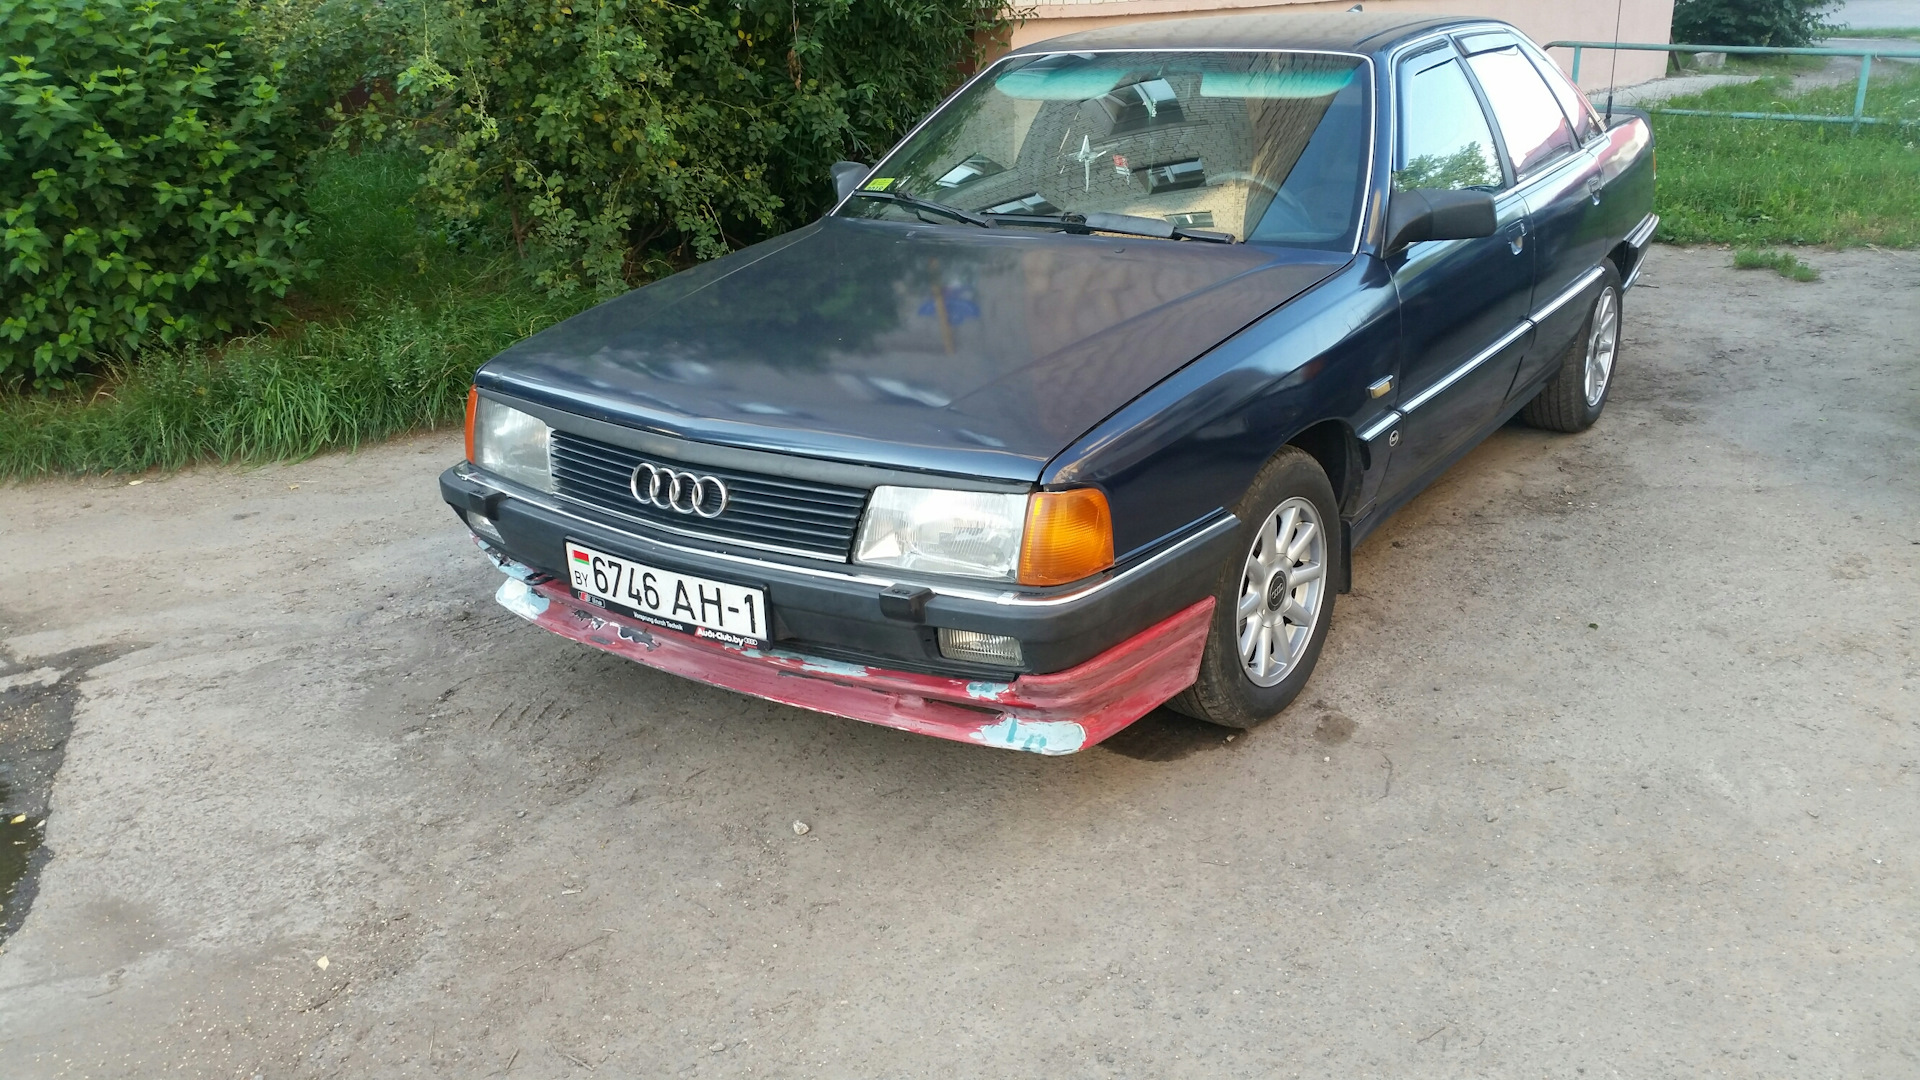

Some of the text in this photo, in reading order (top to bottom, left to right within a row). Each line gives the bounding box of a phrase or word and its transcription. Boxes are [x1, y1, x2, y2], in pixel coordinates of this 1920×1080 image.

[574, 570, 589, 587] BY
[592, 556, 756, 634] 6746 AH-1
